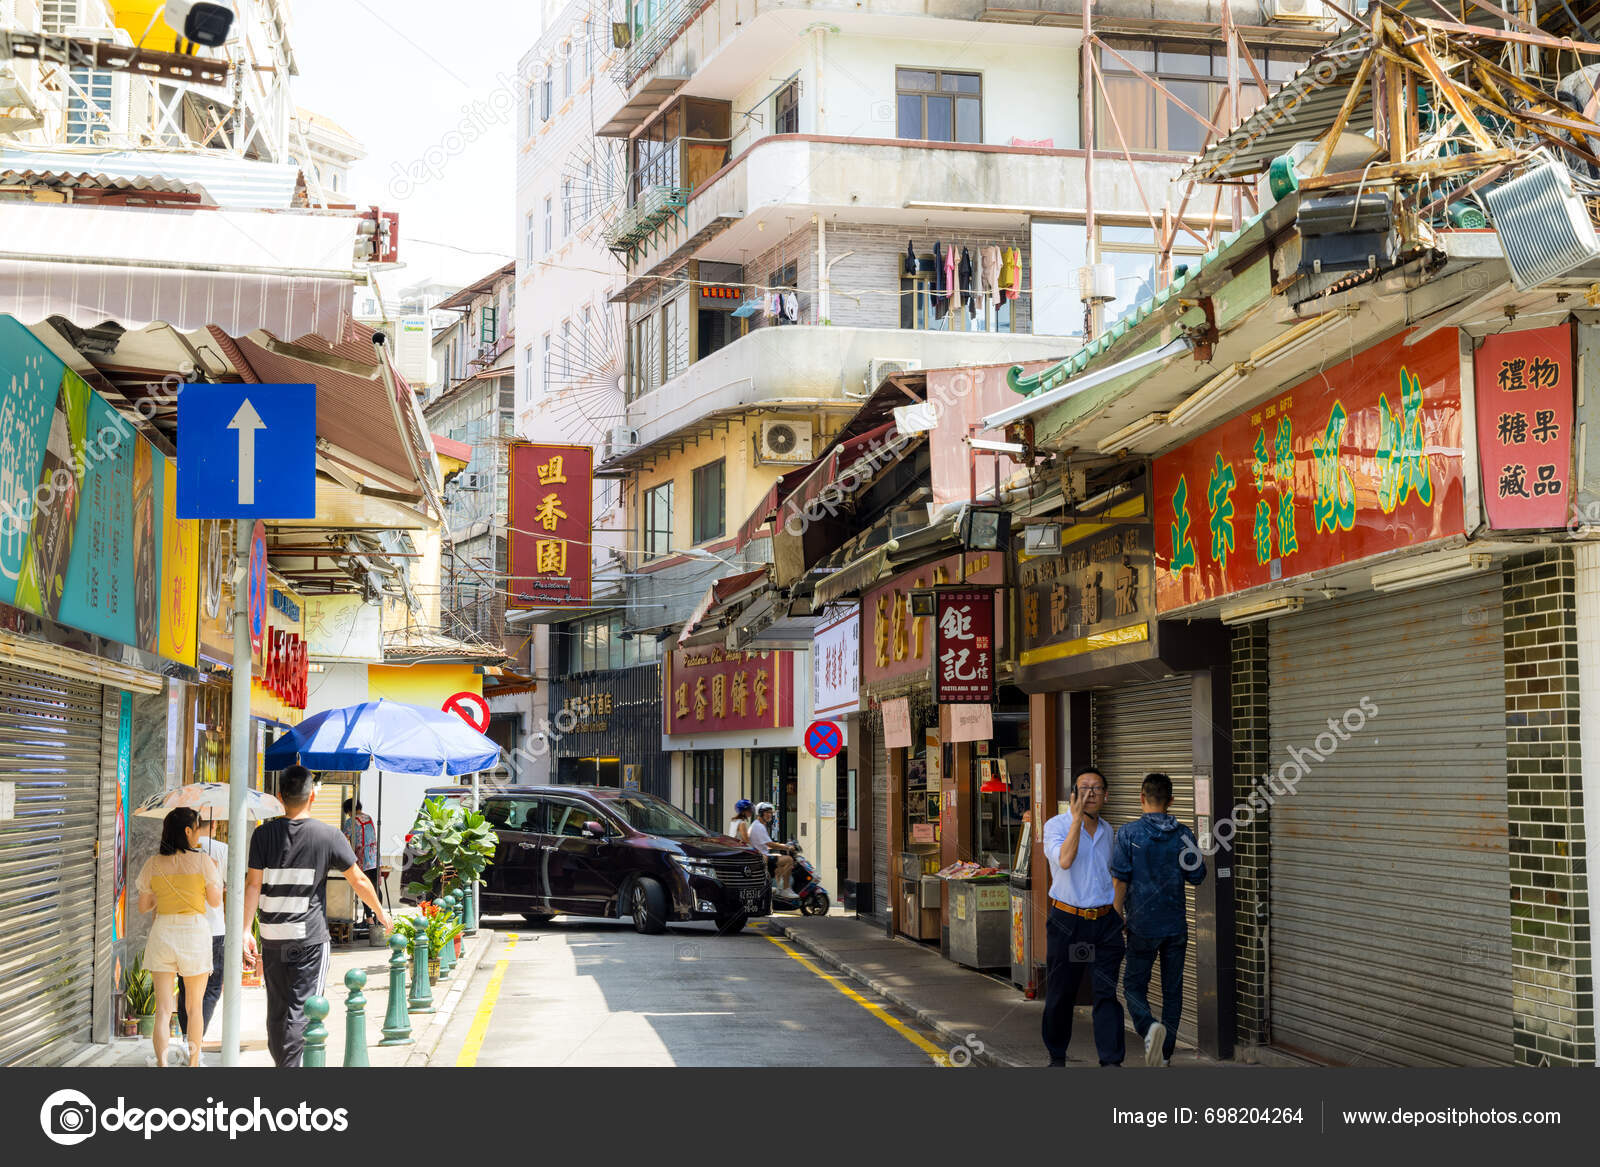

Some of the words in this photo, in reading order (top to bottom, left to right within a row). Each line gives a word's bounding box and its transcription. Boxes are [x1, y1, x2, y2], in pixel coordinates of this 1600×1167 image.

[1499, 356, 1560, 392] 禮物
[1498, 410, 1560, 445] 糖果
[1499, 464, 1562, 499] 藏品
[534, 455, 568, 577] 咀香園
[939, 605, 977, 682] 鉅記
[976, 653, 989, 680] 手信
[674, 668, 768, 721] 咀香園餅家
